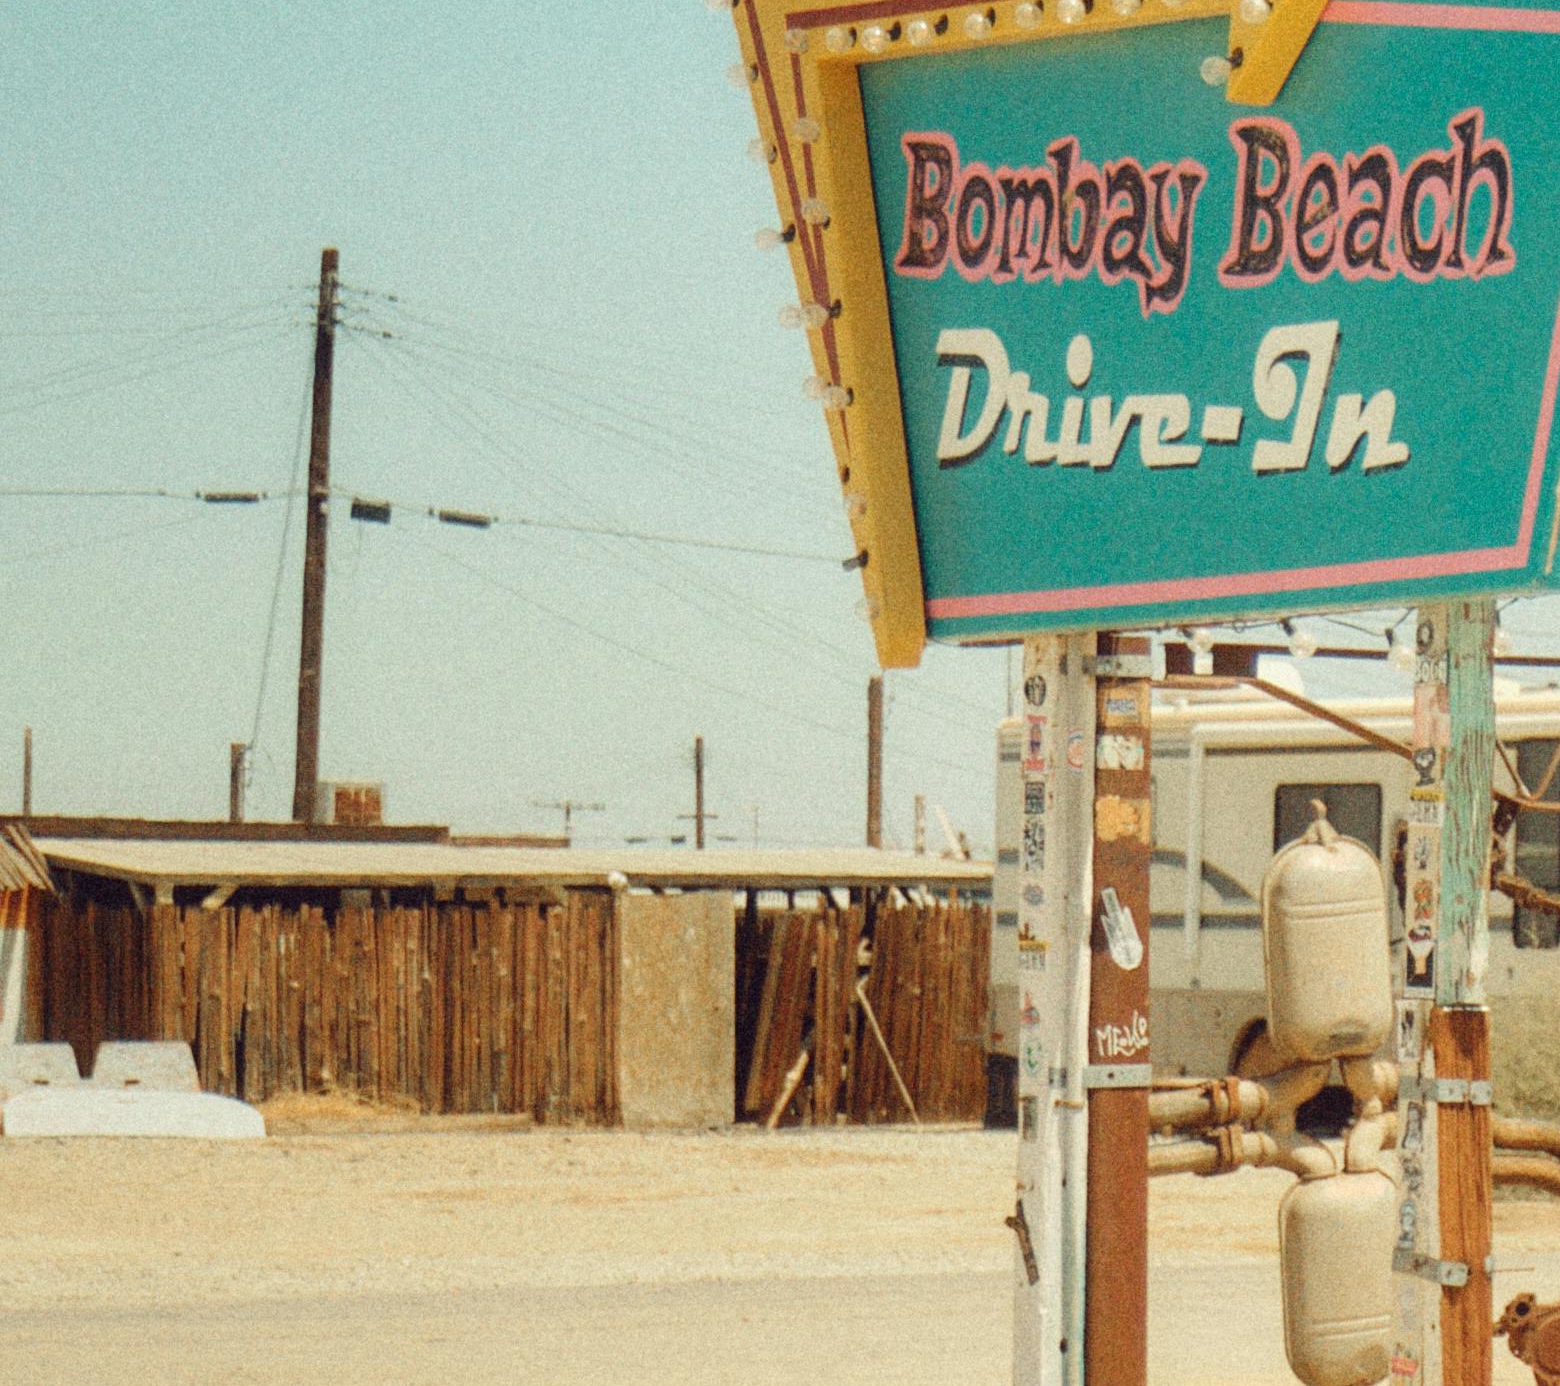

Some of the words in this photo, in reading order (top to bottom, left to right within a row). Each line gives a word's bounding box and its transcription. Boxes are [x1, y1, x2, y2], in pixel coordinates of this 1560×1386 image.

[897, 131, 1204, 317] Bombay
[1220, 107, 1514, 288] Beach
[935, 319, 1410, 473] Drive-In
